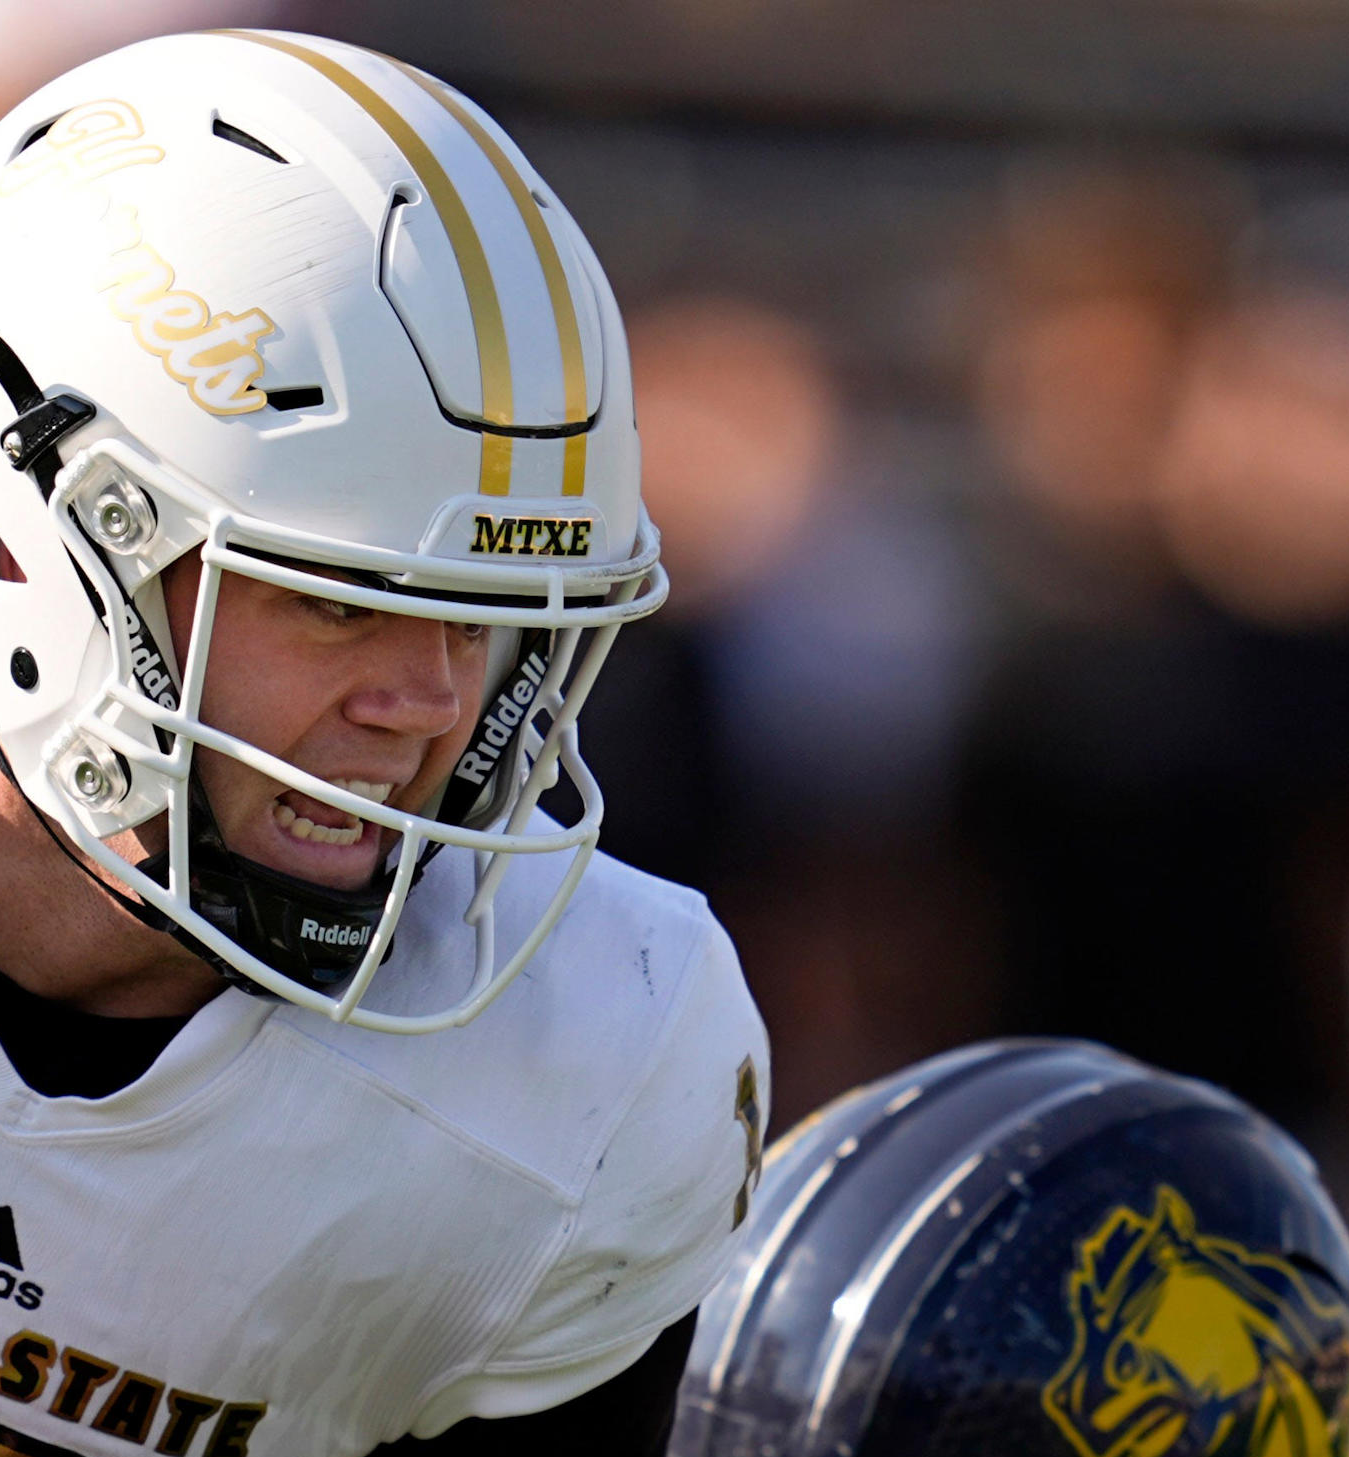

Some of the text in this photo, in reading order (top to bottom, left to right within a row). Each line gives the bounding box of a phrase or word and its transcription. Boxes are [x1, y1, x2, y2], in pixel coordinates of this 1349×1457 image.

[468, 513, 594, 557] MTXE
[124, 603, 177, 711] Ridde
[454, 652, 547, 785] Riddell
[300, 918, 370, 946] Riddell
